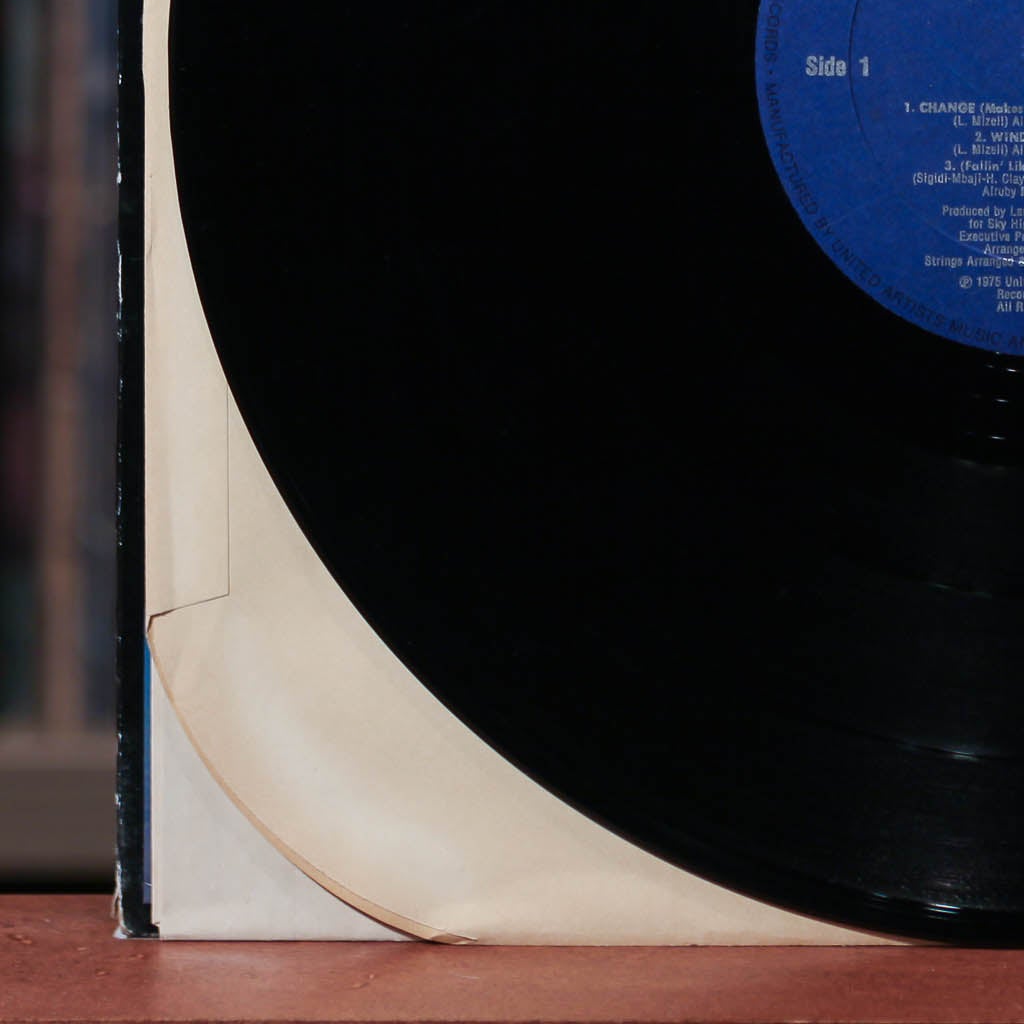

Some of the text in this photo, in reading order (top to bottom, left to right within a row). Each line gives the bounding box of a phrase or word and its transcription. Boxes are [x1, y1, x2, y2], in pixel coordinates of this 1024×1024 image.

[805, 56, 869, 77] Side 1
[904, 102, 914, 113] 1.
[919, 102, 975, 113] CHANGE
[980, 103, 1023, 114] (Makes
[975, 132, 986, 142] 2.
[945, 160, 956, 171] 3.
[763, 83, 821, 217] MANUFACTURED
[812, 214, 836, 239] BY
[829, 236, 884, 289] UNITED
[881, 282, 947, 327] ARTISTS
[947, 316, 1002, 345] MUSIC
[942, 205, 990, 216] Produced
[994, 206, 1006, 218] by
[969, 219, 983, 229] for
[987, 218, 1007, 230] Sky
[960, 231, 1010, 241] Executive
[924, 256, 963, 268] Strings
[967, 256, 1014, 268] Arranged
[976, 276, 1001, 287] 1975
[996, 301, 1012, 312] All
